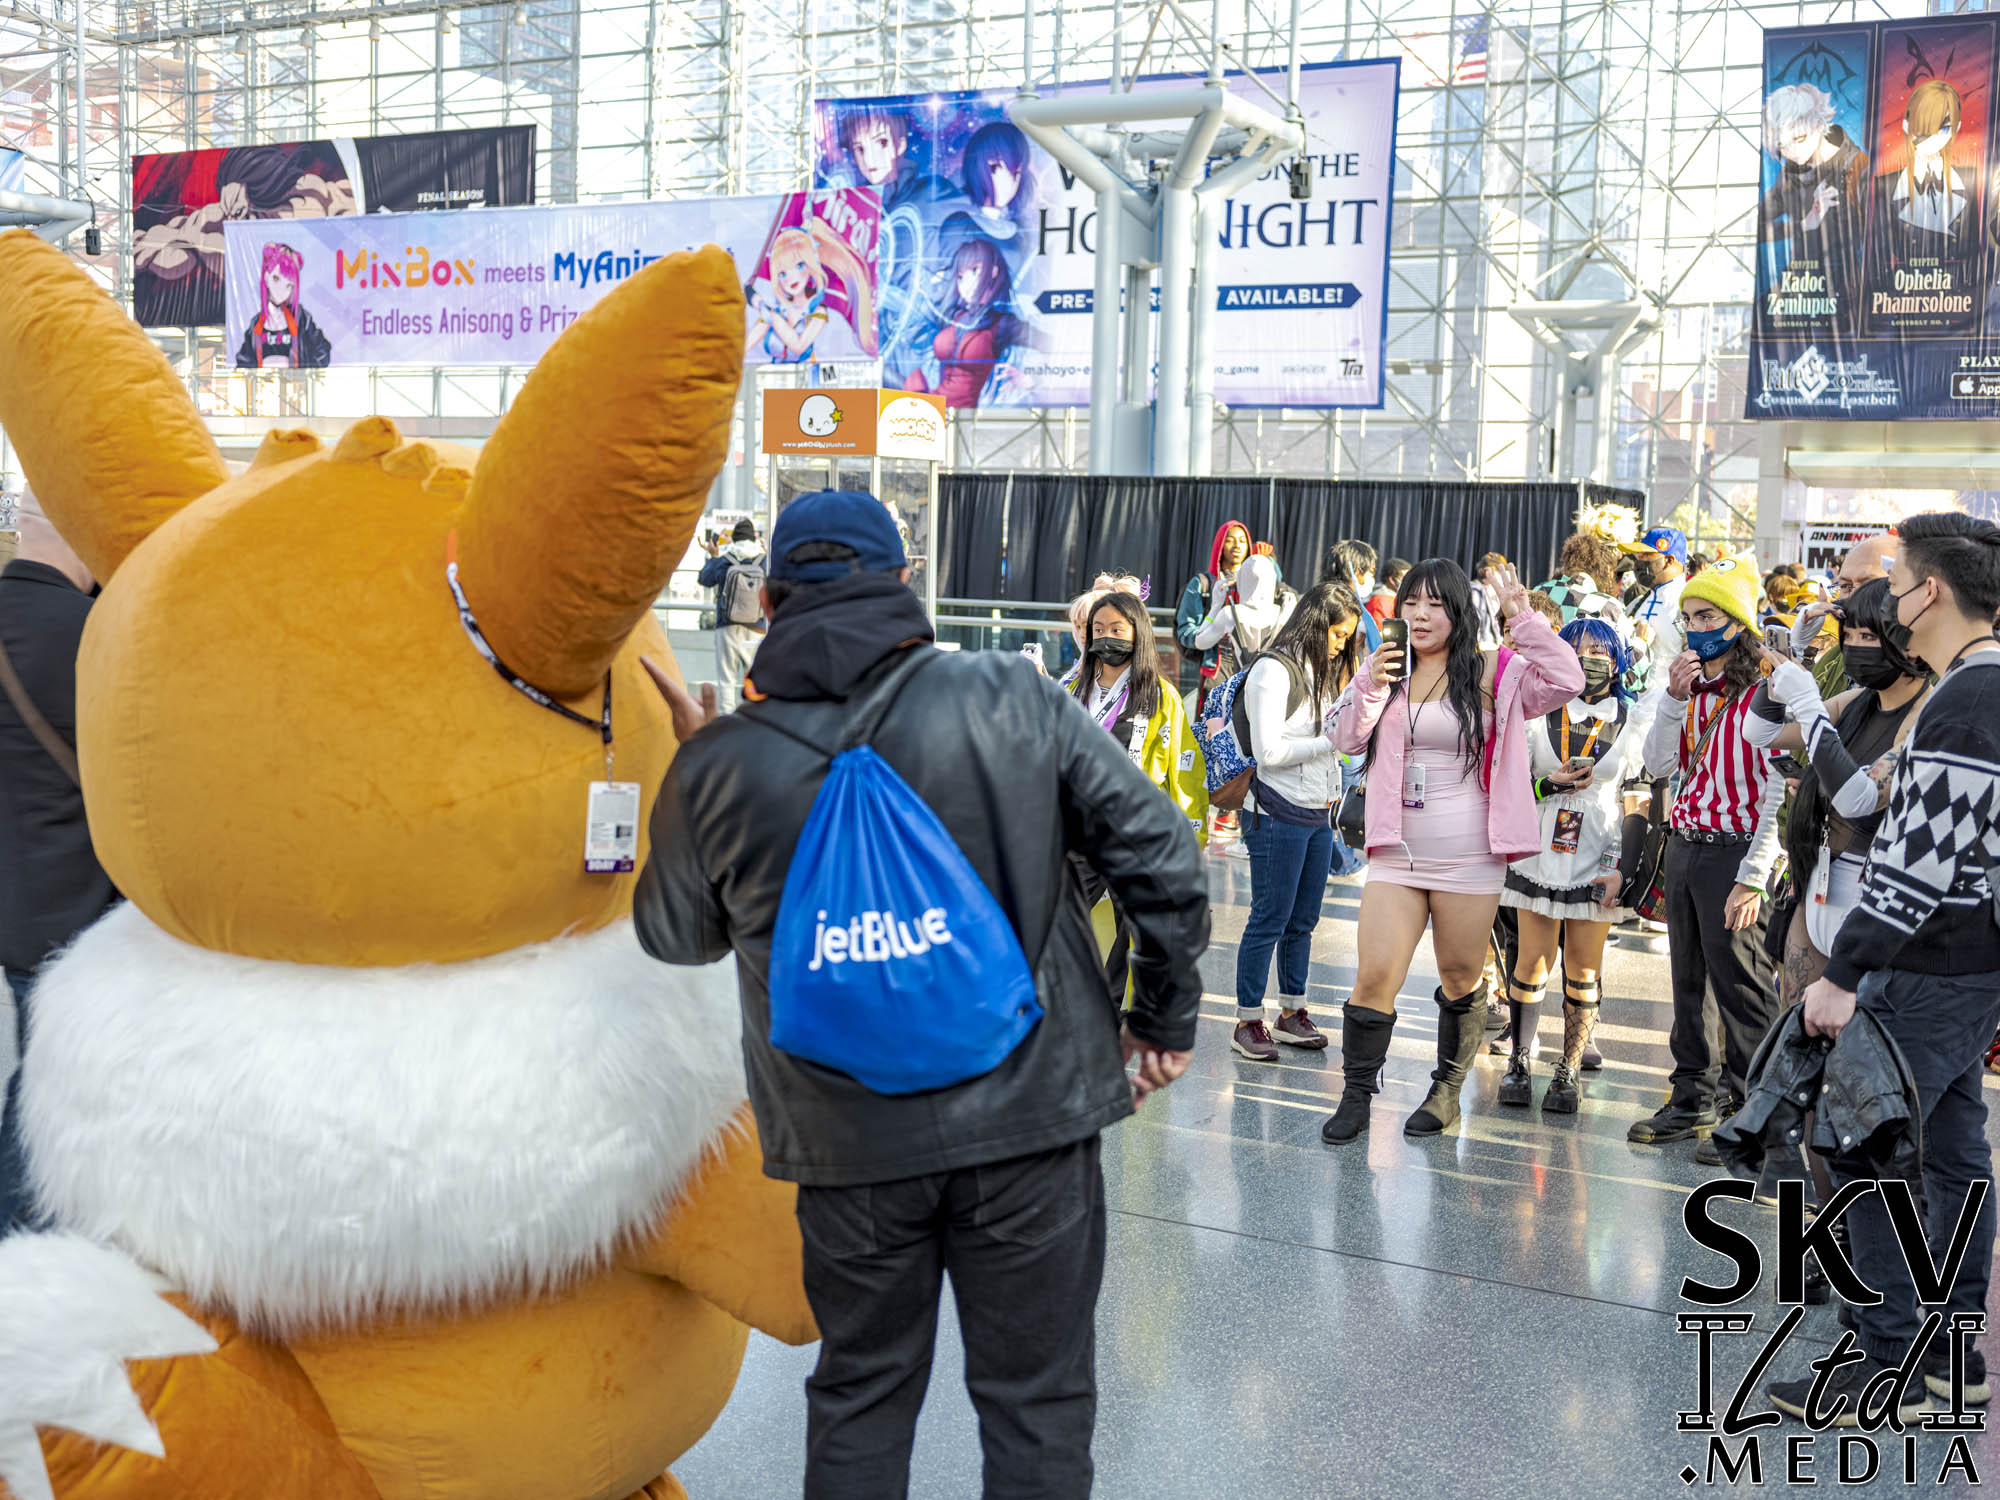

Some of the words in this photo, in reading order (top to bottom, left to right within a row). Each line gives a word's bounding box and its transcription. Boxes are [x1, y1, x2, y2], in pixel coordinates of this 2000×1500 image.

[336, 246, 476, 290] MixBox
[484, 263, 545, 284] meets
[1781, 271, 1826, 293] Kadoc
[1895, 268, 1951, 294] Ophelia
[1225, 288, 1344, 305] AVAILABLE!
[1767, 293, 1838, 318] Zemlupus
[1872, 291, 1972, 314] Phamrsolone
[362, 308, 433, 336] Endless
[438, 306, 514, 340] Anisong
[520, 306, 533, 333] &
[808, 907, 953, 971] jetBlue
